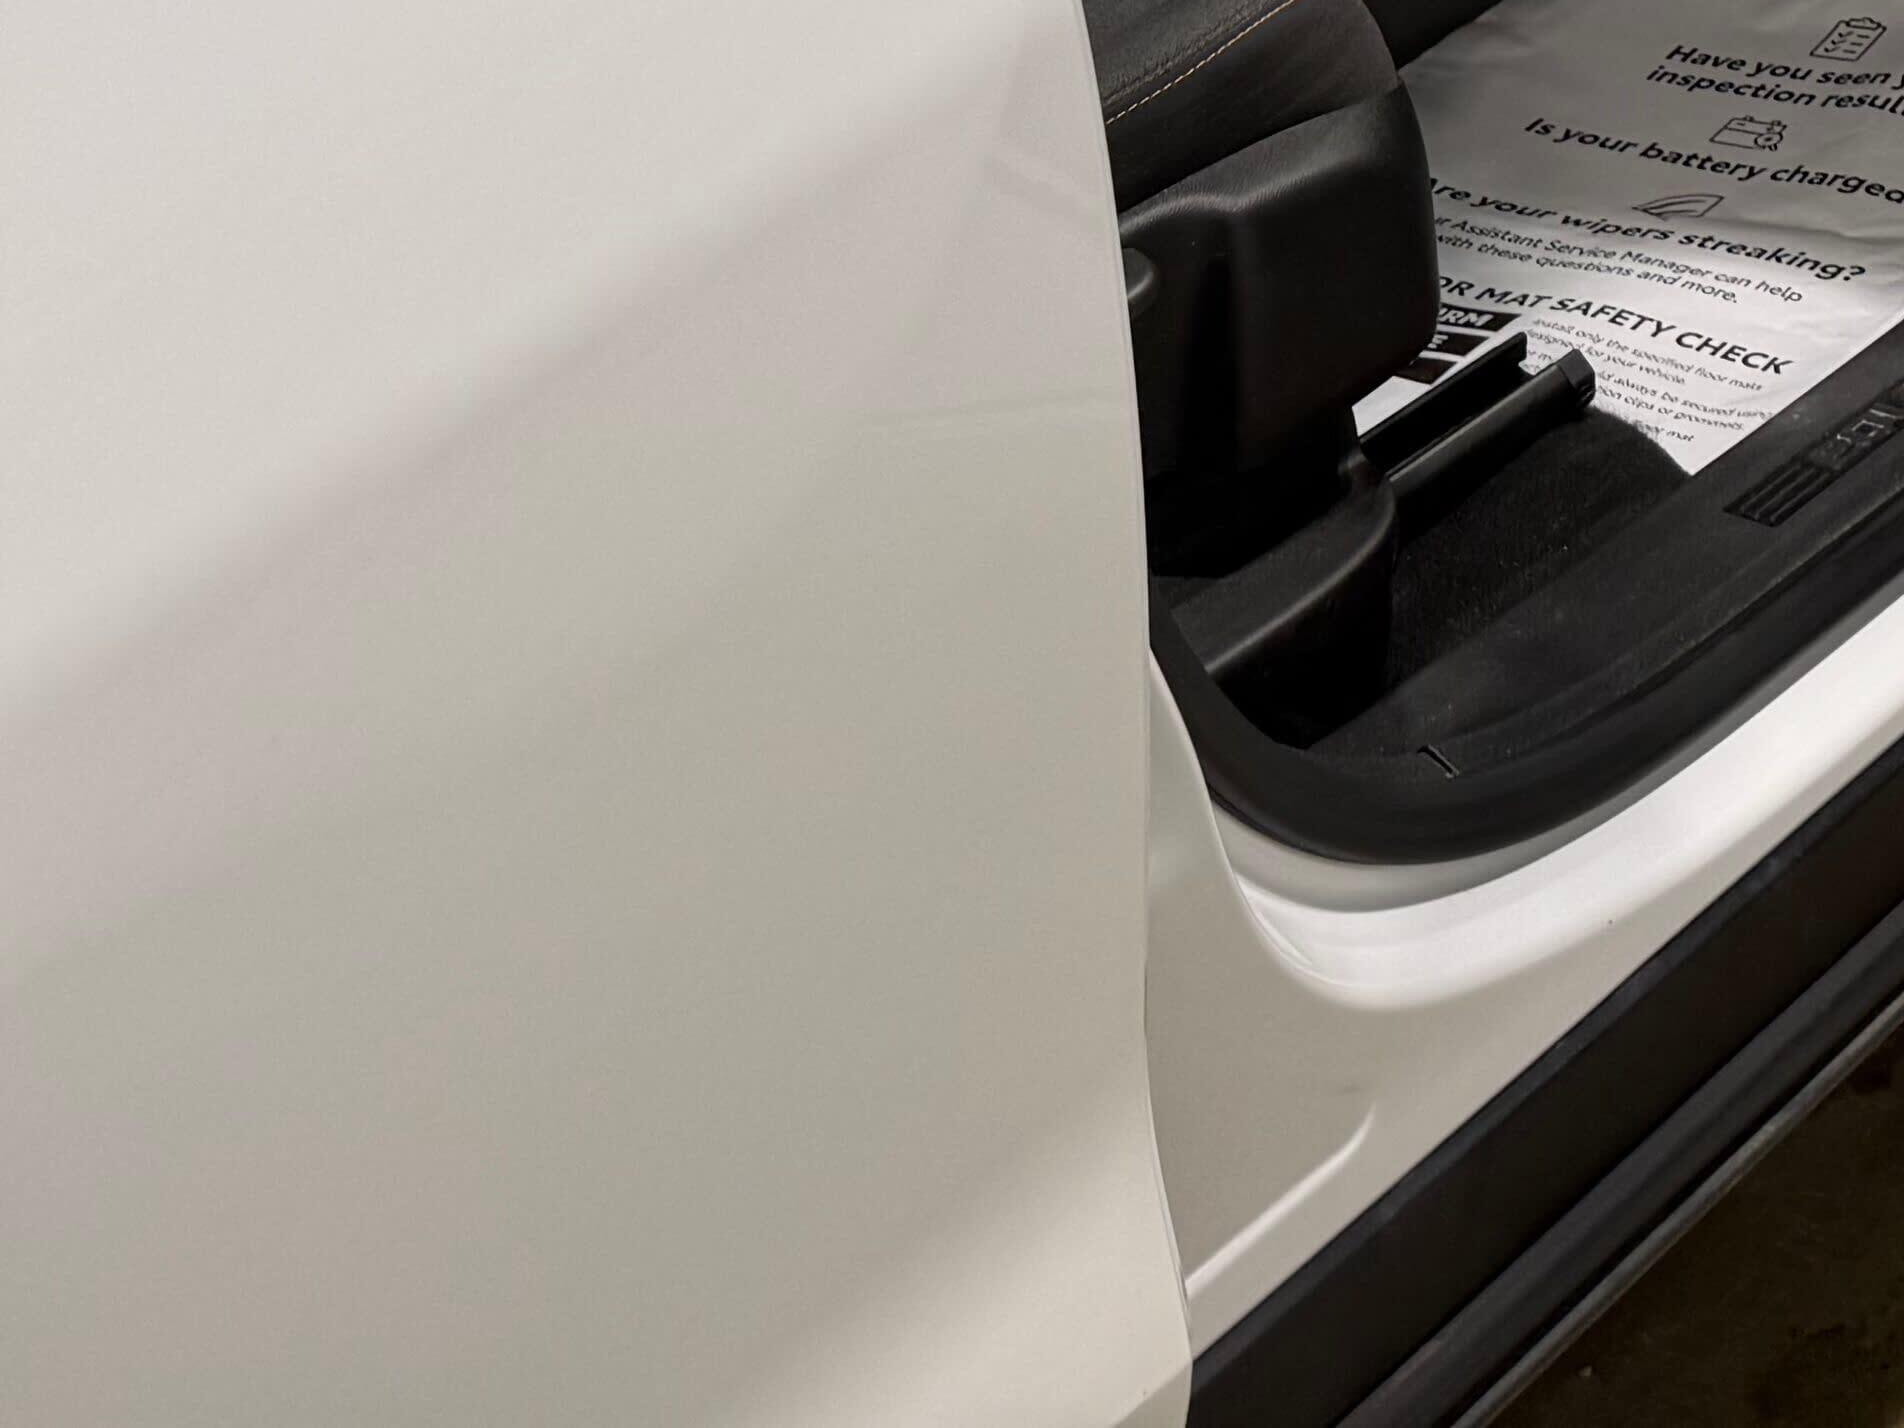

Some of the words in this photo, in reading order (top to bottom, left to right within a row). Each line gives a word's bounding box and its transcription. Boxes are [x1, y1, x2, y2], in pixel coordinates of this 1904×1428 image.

[1646, 64, 1817, 107] inspection
[1666, 45, 1747, 72] Have
[1747, 61, 1813, 81] you
[1816, 70, 1891, 86] seen
[1524, 117, 1556, 136] Is
[1552, 128, 1640, 153] your
[1639, 141, 1767, 182] battery
[1438, 233, 1474, 250] with
[1477, 242, 1534, 263] these
[1536, 255, 1633, 277] questions
[1635, 267, 1682, 287] and
[1681, 277, 1739, 304] more.
[1450, 220, 1544, 248] Assistant
[1544, 239, 1617, 260] Service
[1620, 250, 1713, 279] Manager
[1714, 271, 1752, 287] can
[1755, 279, 1804, 303] help
[1470, 195, 1558, 219] your
[1561, 215, 1676, 242] wipers
[1677, 231, 1867, 282] streaking?
[1475, 287, 1554, 309] MAT
[1549, 297, 1677, 339] SAFETY
[1675, 331, 1795, 375] CHECK
